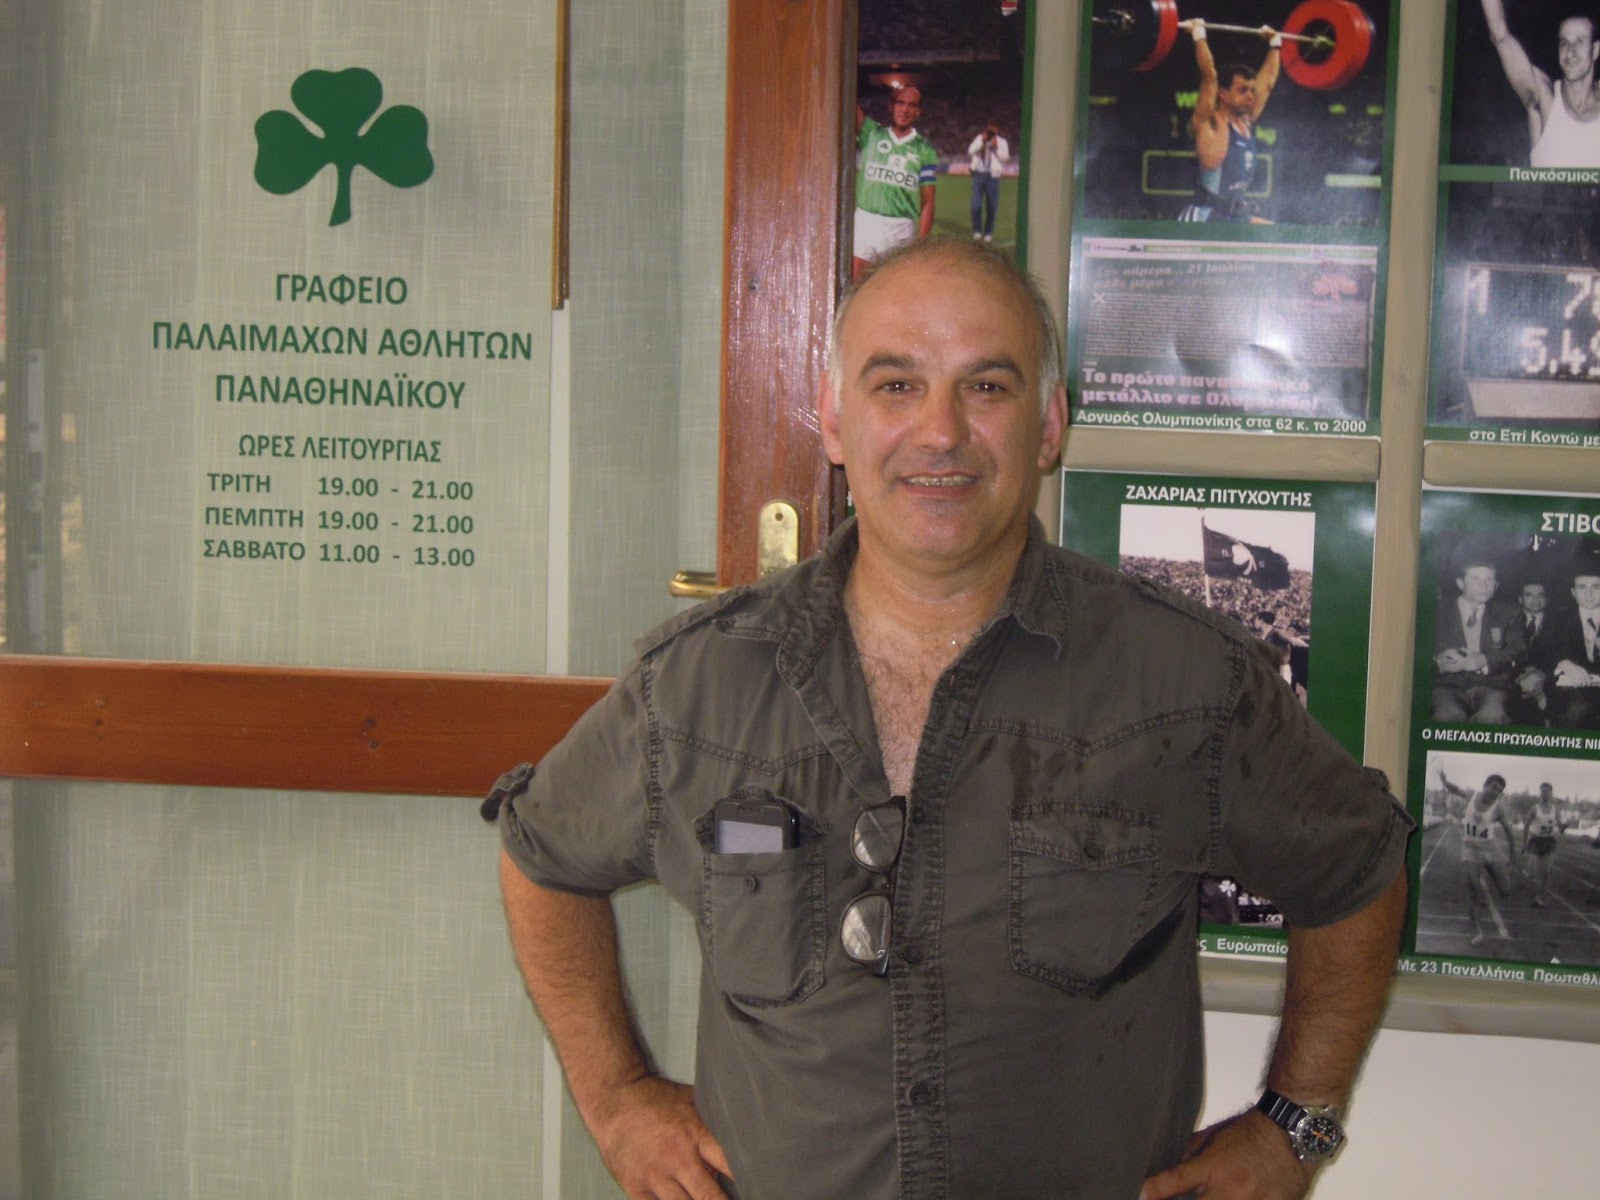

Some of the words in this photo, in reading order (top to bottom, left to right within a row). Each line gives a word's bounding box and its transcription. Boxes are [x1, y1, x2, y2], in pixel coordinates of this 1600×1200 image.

[275, 273, 408, 305] ΓΡΑΦΕΙΟ
[152, 321, 368, 355] ΠΑΛΑΙΜΑΧΩΝ
[377, 328, 532, 361] ΑΘΛΗΤΩΝ
[215, 372, 466, 409] ΠΑΝΑΘΗΝΑΪΚΟΥ
[1083, 367, 1107, 383] Το
[1110, 370, 1176, 388] πρώτο
[1082, 388, 1173, 405] μετάλλιο
[1177, 394, 1201, 404] σε
[1076, 409, 1138, 425] Αργυρός
[1142, 412, 1242, 431] Ολυμπιονίκης
[1246, 417, 1272, 428] στα
[1275, 417, 1293, 431] 62
[1297, 420, 1309, 431] κ.
[1313, 421, 1329, 432] το
[1333, 419, 1367, 433] 2000
[238, 434, 296, 458] ΩΡΕΣ
[301, 436, 442, 463] ΛΕΙΤΟΥΡΓΙΑΣ
[1469, 430, 1496, 441] στο
[1500, 429, 1526, 443] Επί
[1531, 429, 1580, 445] Κοντώ
[1584, 435, 1600, 448] με
[206, 472, 271, 493] ΤΡΙΤΗ
[317, 476, 379, 497] 19.00
[411, 479, 473, 501] 21.00
[1125, 485, 1206, 503] ΖΑΧΑΡΙΑΣ
[1210, 488, 1312, 508] ΠΙΤΥΧΟΥΤΗΣ
[205, 506, 304, 529] ΠΕΜΠΤΗ
[317, 510, 379, 531] 19.00
[411, 513, 474, 535] 21.00
[203, 539, 306, 561] ΣΑΒΒΑΤΟ
[318, 543, 380, 564] 11.00
[413, 546, 475, 567] 13.00
[1421, 728, 1432, 740] Ο
[1434, 729, 1491, 744] ΜΕΓΑΛΟΣ
[1494, 732, 1582, 750] ΠΡΩΤΑΘΛΗΤΗΣ
[1585, 738, 1600, 750] ΝΙ
[1397, 959, 1417, 972] Με
[1420, 960, 1437, 974] 23
[1442, 962, 1525, 981] Πανελλήνια
[1533, 968, 1600, 986] Πρωταθλ
